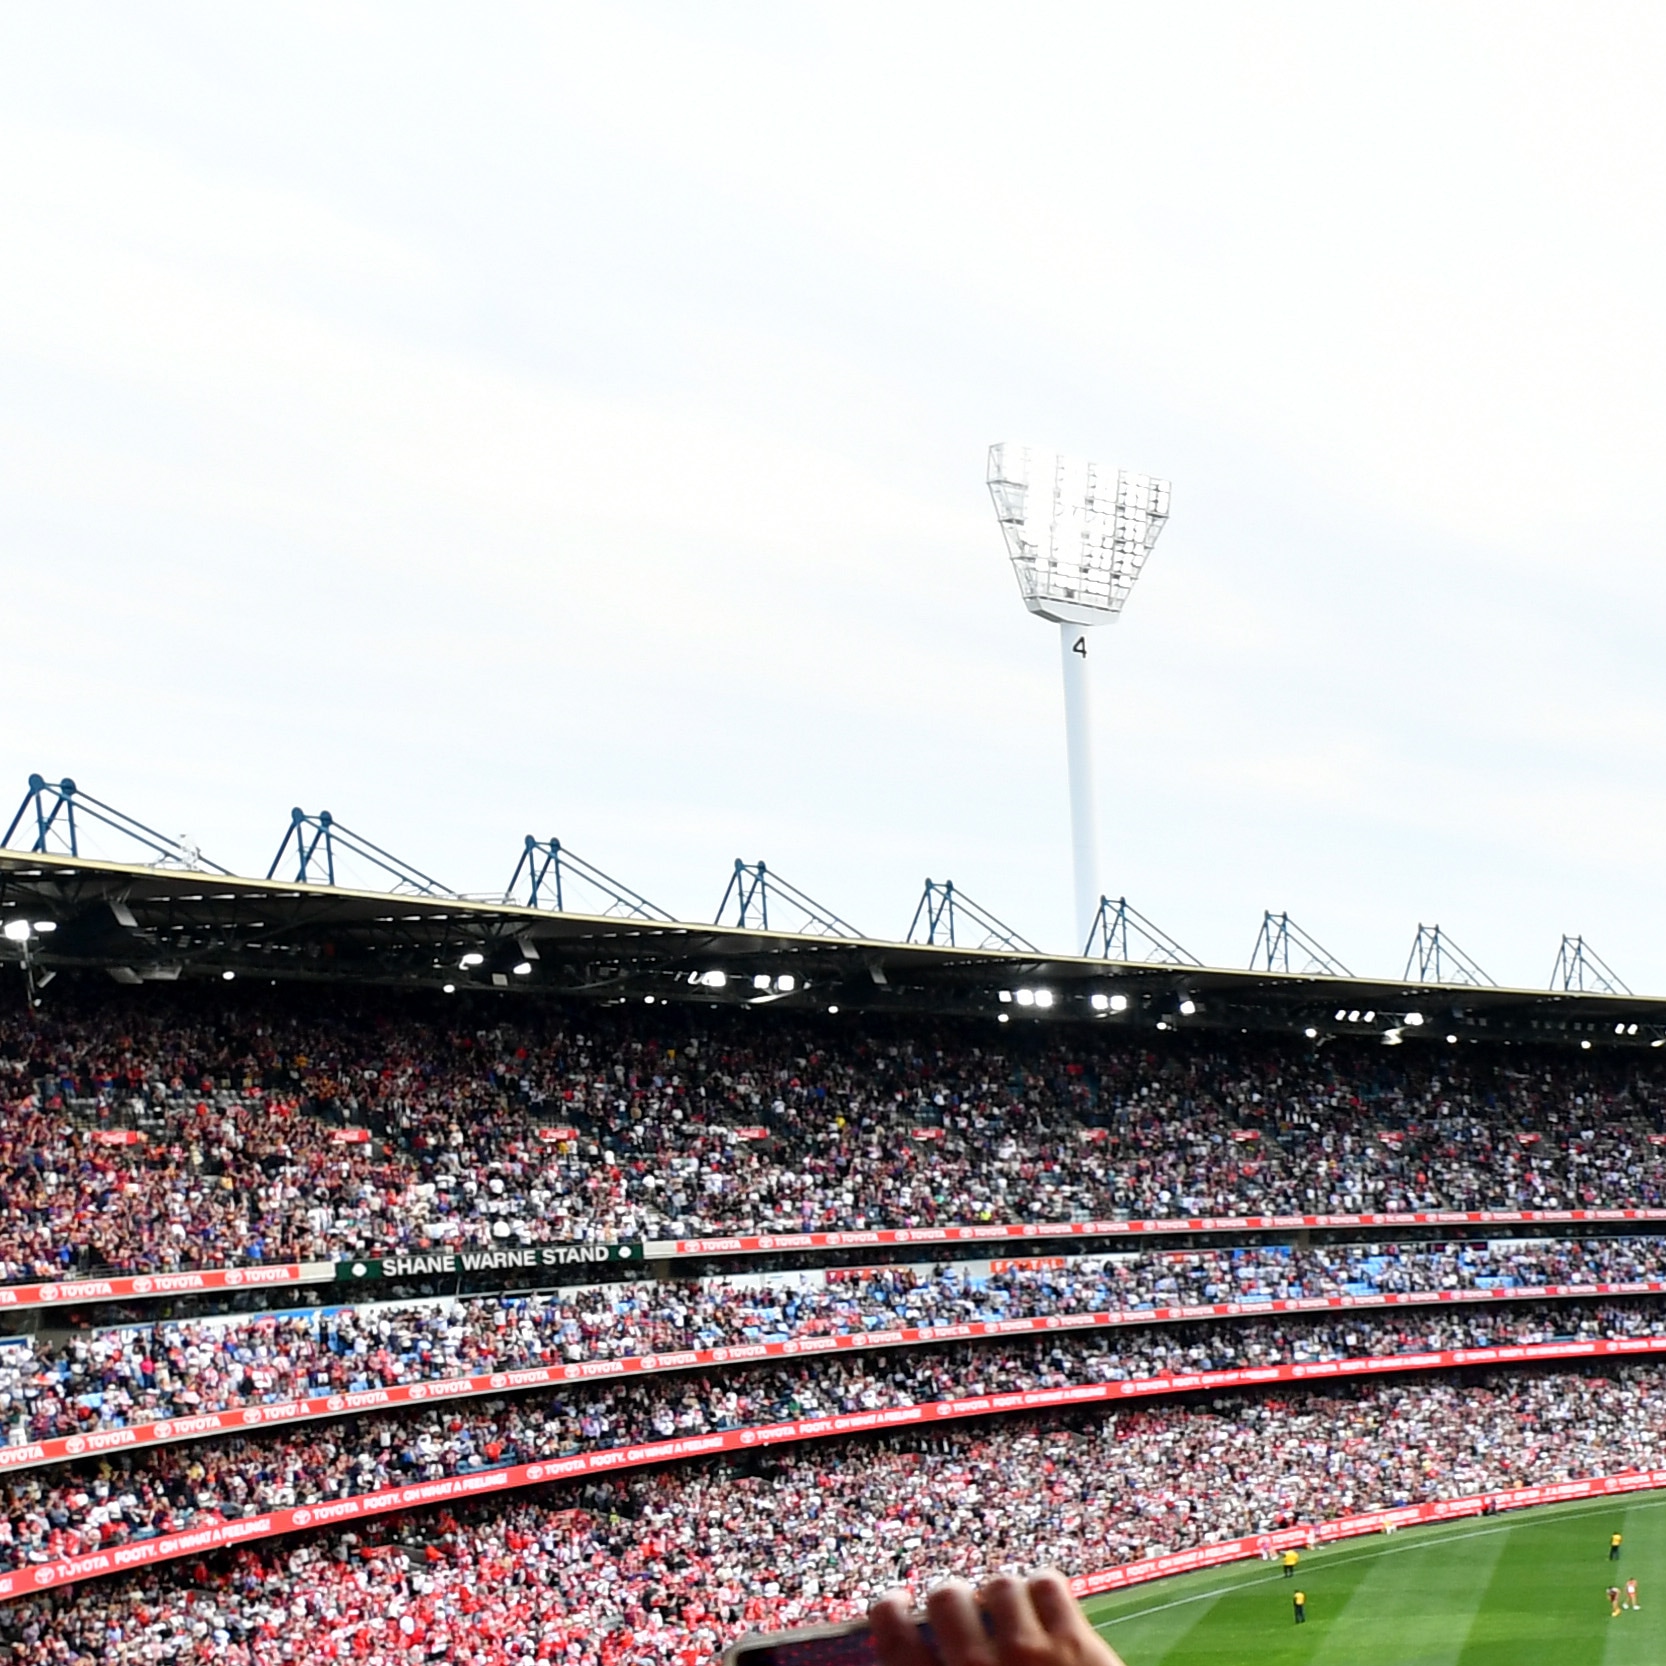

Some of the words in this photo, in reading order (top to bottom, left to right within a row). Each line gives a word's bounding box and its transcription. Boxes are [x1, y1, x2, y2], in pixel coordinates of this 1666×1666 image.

[1073, 636, 1086, 658] 4
[702, 1240, 740, 1250] TOYOTA
[382, 1255, 456, 1277] SHANE
[462, 1250, 537, 1270] WARNE
[542, 1246, 609, 1265] STAND
[152, 1274, 204, 1290] TOYOTA
[242, 1268, 290, 1281] TOYOTA
[59, 1282, 112, 1298] TOYOTA
[800, 1338, 837, 1351] TOYOTA
[866, 1331, 903, 1344] TOYOTA
[657, 1352, 697, 1366] TOYOTA
[729, 1346, 767, 1358] TOYOTA
[580, 1361, 624, 1376] TOYOTA
[507, 1370, 550, 1385] TOYOTA
[429, 1381, 473, 1396] TOYOTA
[347, 1391, 389, 1407] TOYOTA
[173, 1419, 222, 1435] TOYOTA
[756, 1425, 796, 1440] TOYOTA
[88, 1430, 136, 1448] TOYOTA
[0, 1445, 45, 1461] OYOTA
[545, 1460, 586, 1475] TOYOTA
[314, 1501, 359, 1520] TOYOTA
